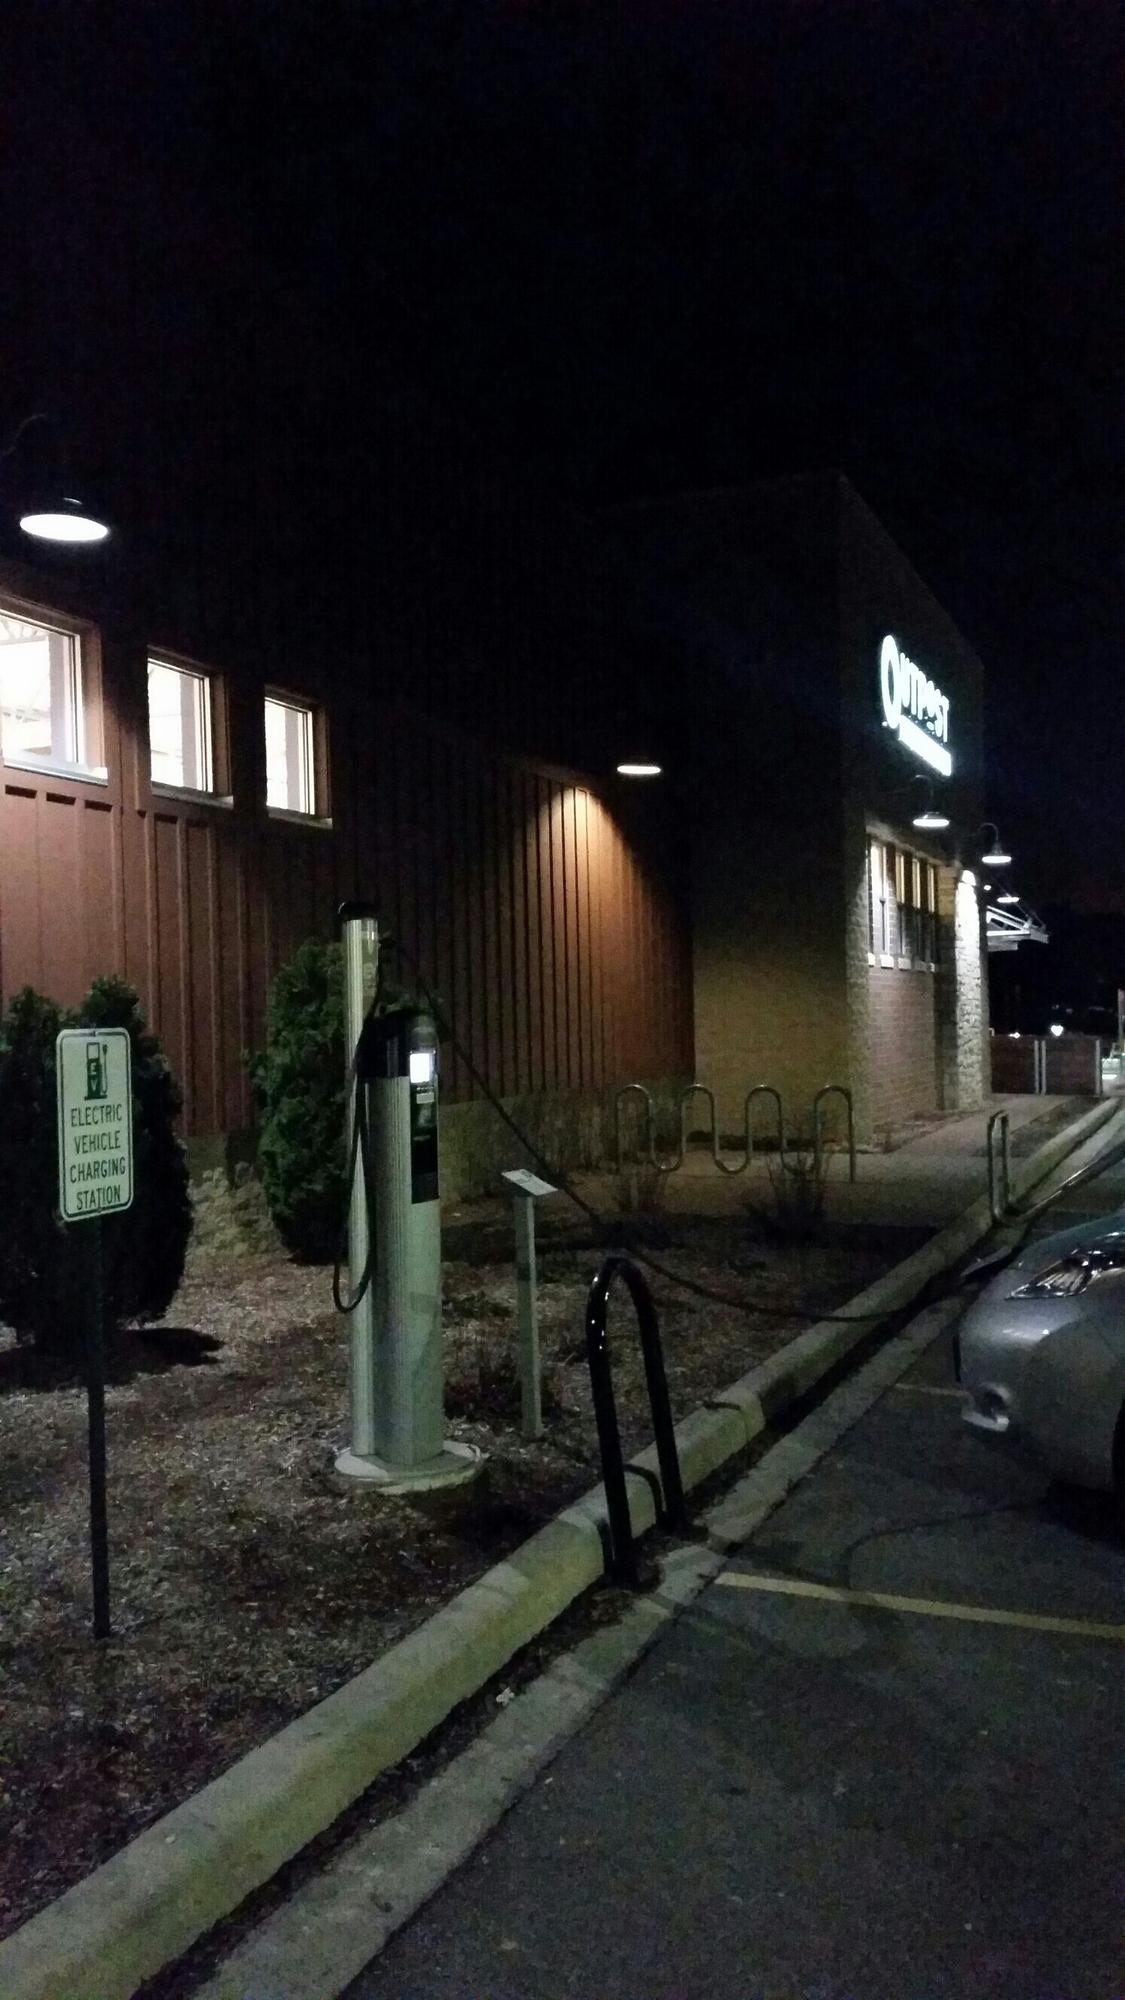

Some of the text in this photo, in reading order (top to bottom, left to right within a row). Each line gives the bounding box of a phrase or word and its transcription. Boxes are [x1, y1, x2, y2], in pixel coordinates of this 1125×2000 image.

[71, 1103, 122, 1127] ELECTRIC
[74, 1130, 121, 1154] VEHICLE
[70, 1157, 126, 1184] CHARGING
[76, 1184, 121, 1210] STATION
